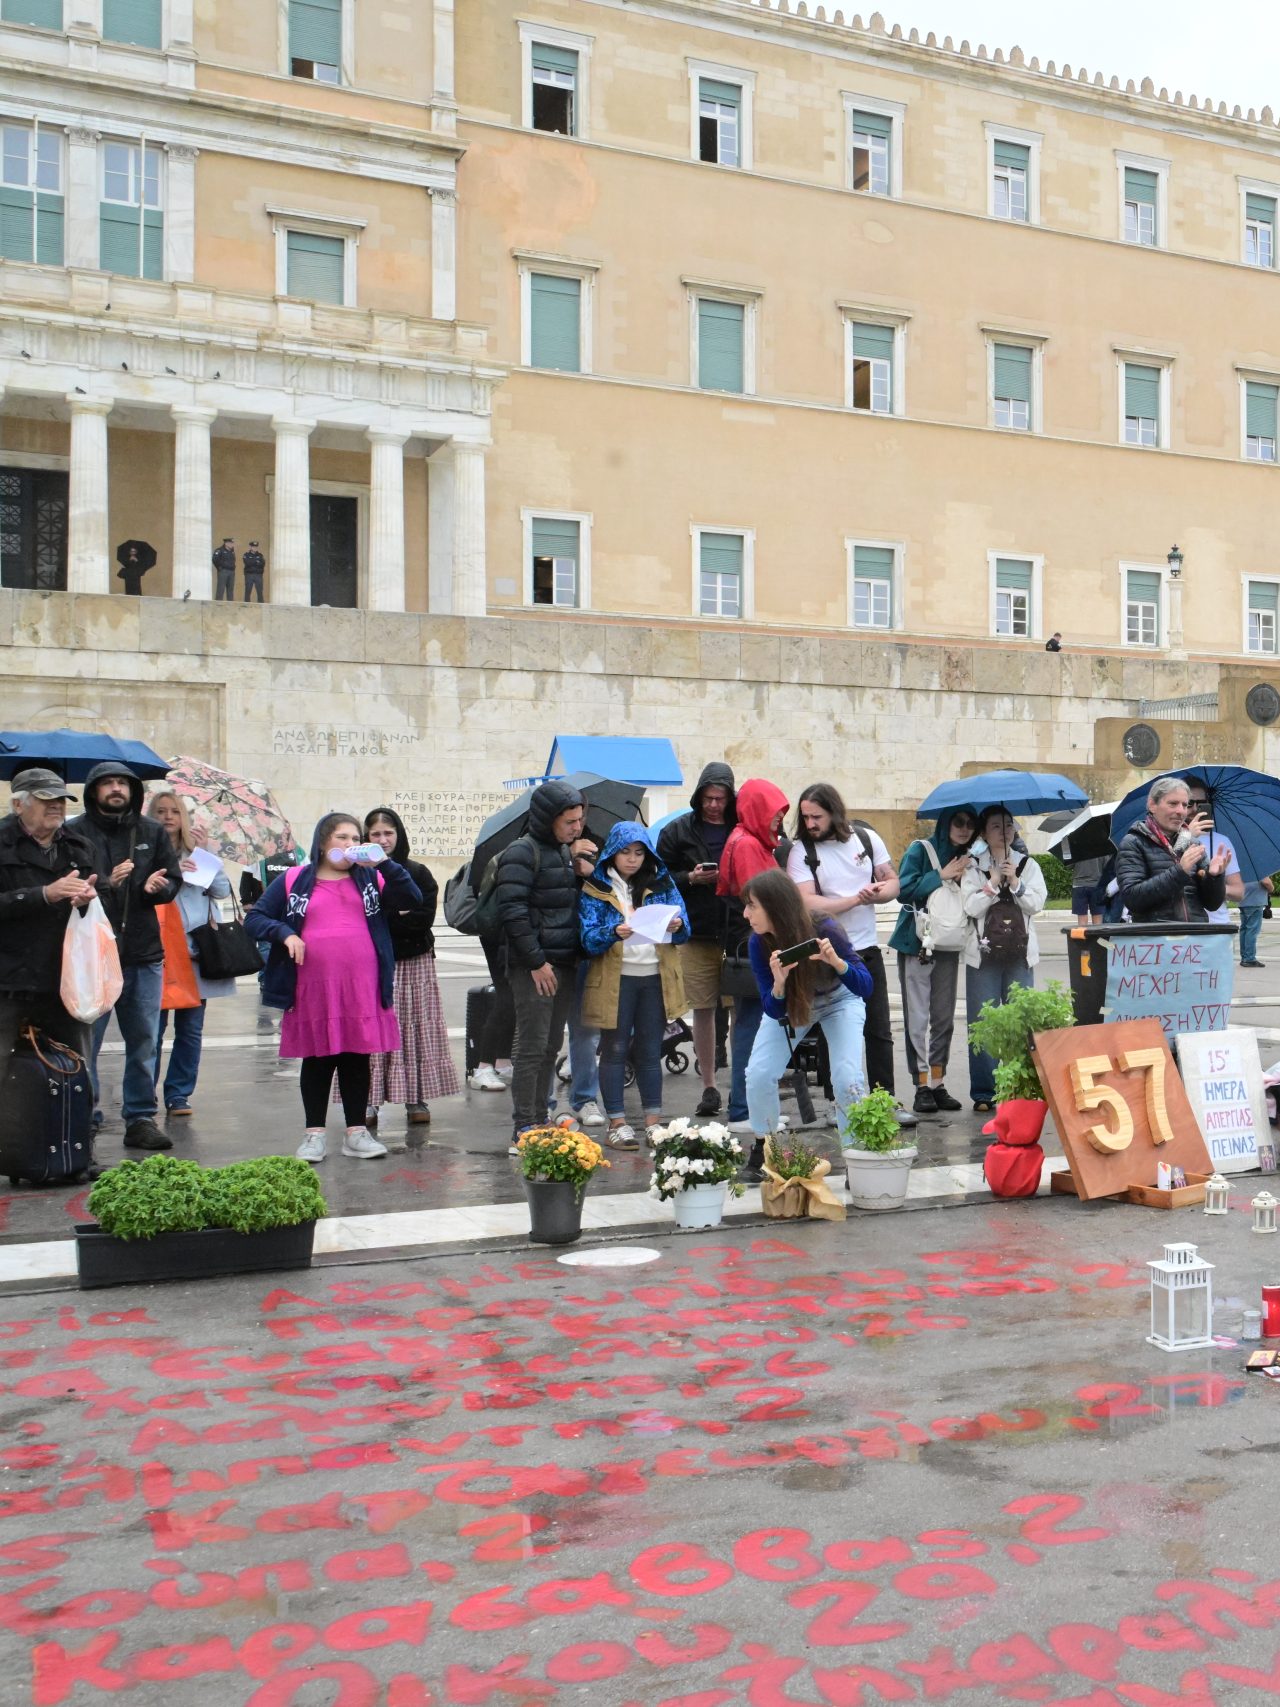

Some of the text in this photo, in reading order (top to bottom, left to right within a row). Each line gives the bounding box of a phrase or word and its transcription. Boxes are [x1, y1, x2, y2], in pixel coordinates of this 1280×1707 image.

[1112, 943, 1204, 968] ΜΑΖΙ ΣΑΣ
[1118, 969, 1219, 999] ΜΕΧΡΙ ΤΗ
[1070, 1047, 1175, 1154] 57
[1204, 1080, 1248, 1101] ΗΜΕΡΑ
[1206, 1107, 1254, 1130] ΑΠΕΡΓΙΑΣ
[1211, 1135, 1257, 1159] ΠΕΙΝΑΣ
[695, 1350, 832, 1387] 26
